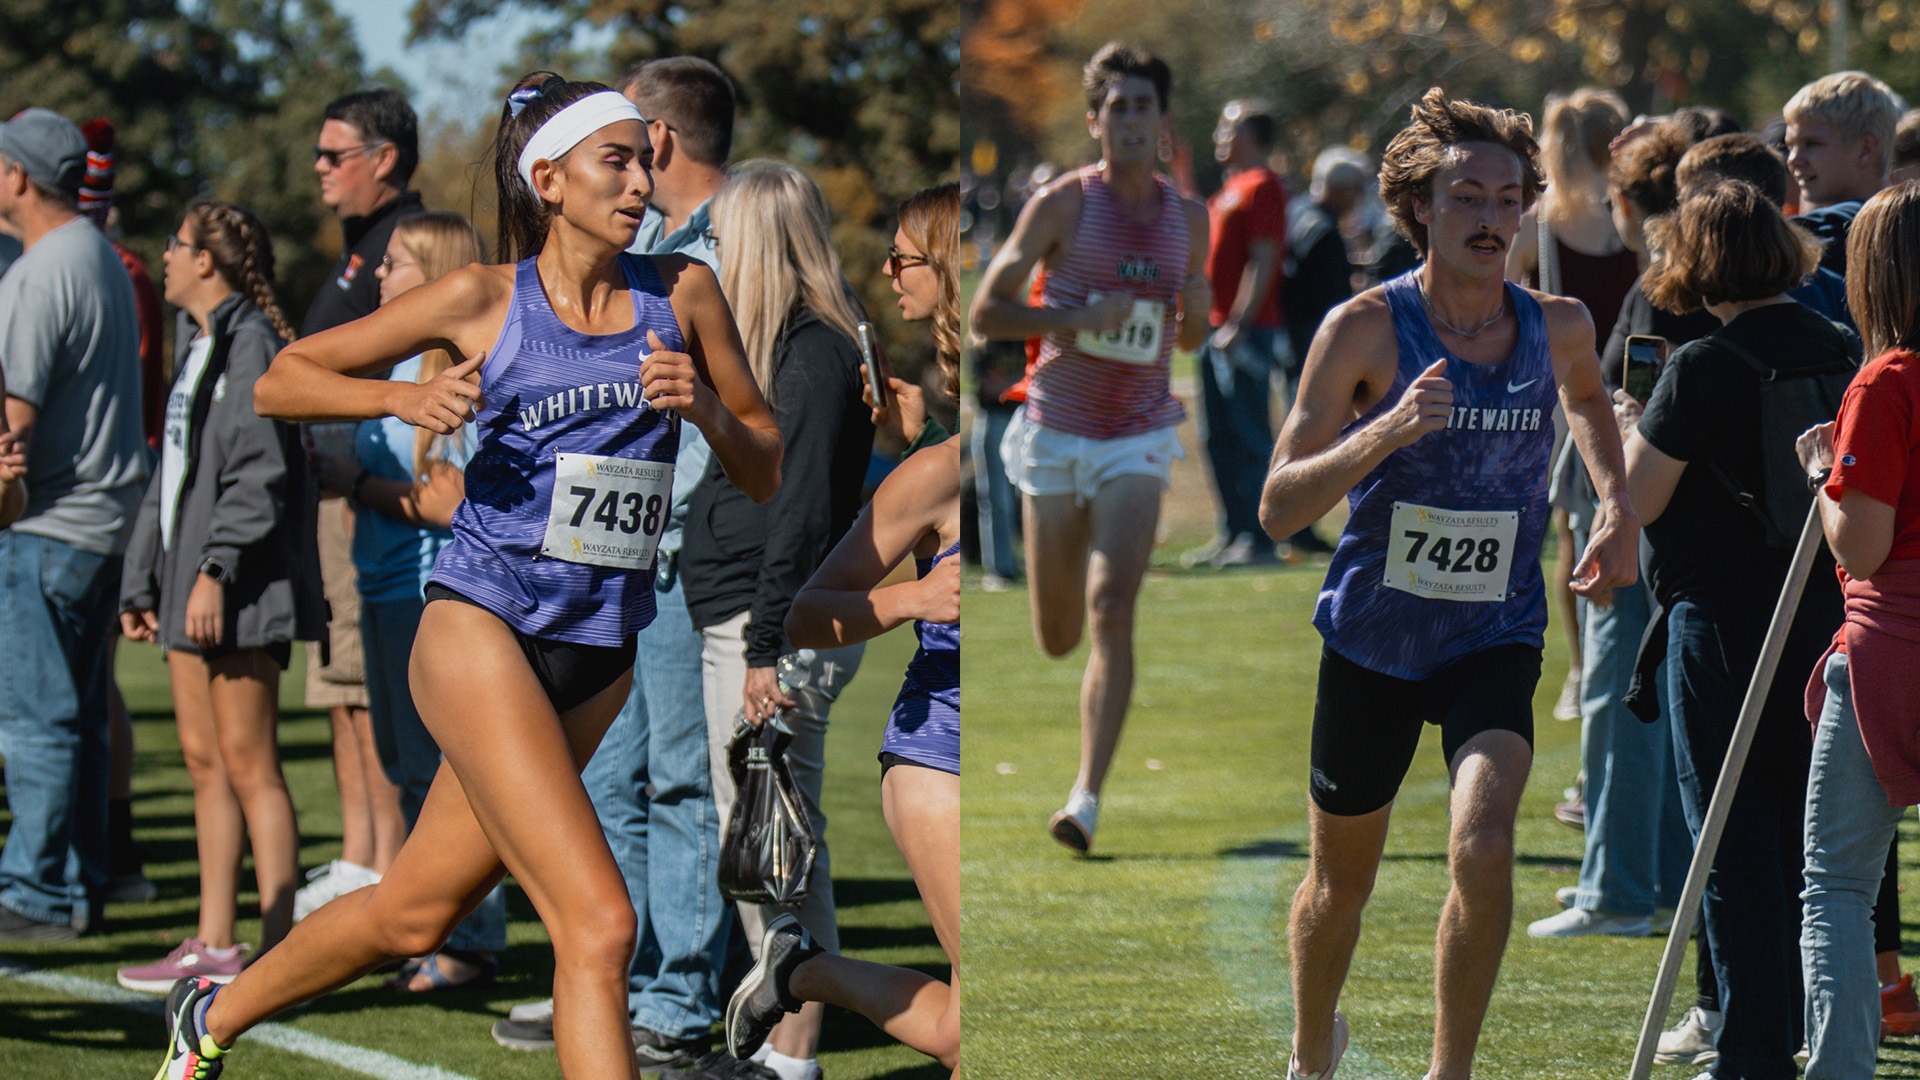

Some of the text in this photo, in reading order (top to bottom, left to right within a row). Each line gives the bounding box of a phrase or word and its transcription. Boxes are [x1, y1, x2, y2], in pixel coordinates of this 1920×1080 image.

[519, 383, 677, 432] WHITEWA
[1447, 406, 1541, 431] ITEWATER
[596, 463, 633, 475] WAYZATA
[635, 467, 664, 479] RESULTS
[569, 485, 662, 537] 7438
[1427, 512, 1499, 525] WAYZATA RESULTS
[582, 542, 621, 555] WAYZATA
[622, 547, 651, 558] RESULTS
[1404, 530, 1500, 573] 7428
[1417, 577, 1453, 591] WAYZATA
[1455, 583, 1487, 592] RESULTS
